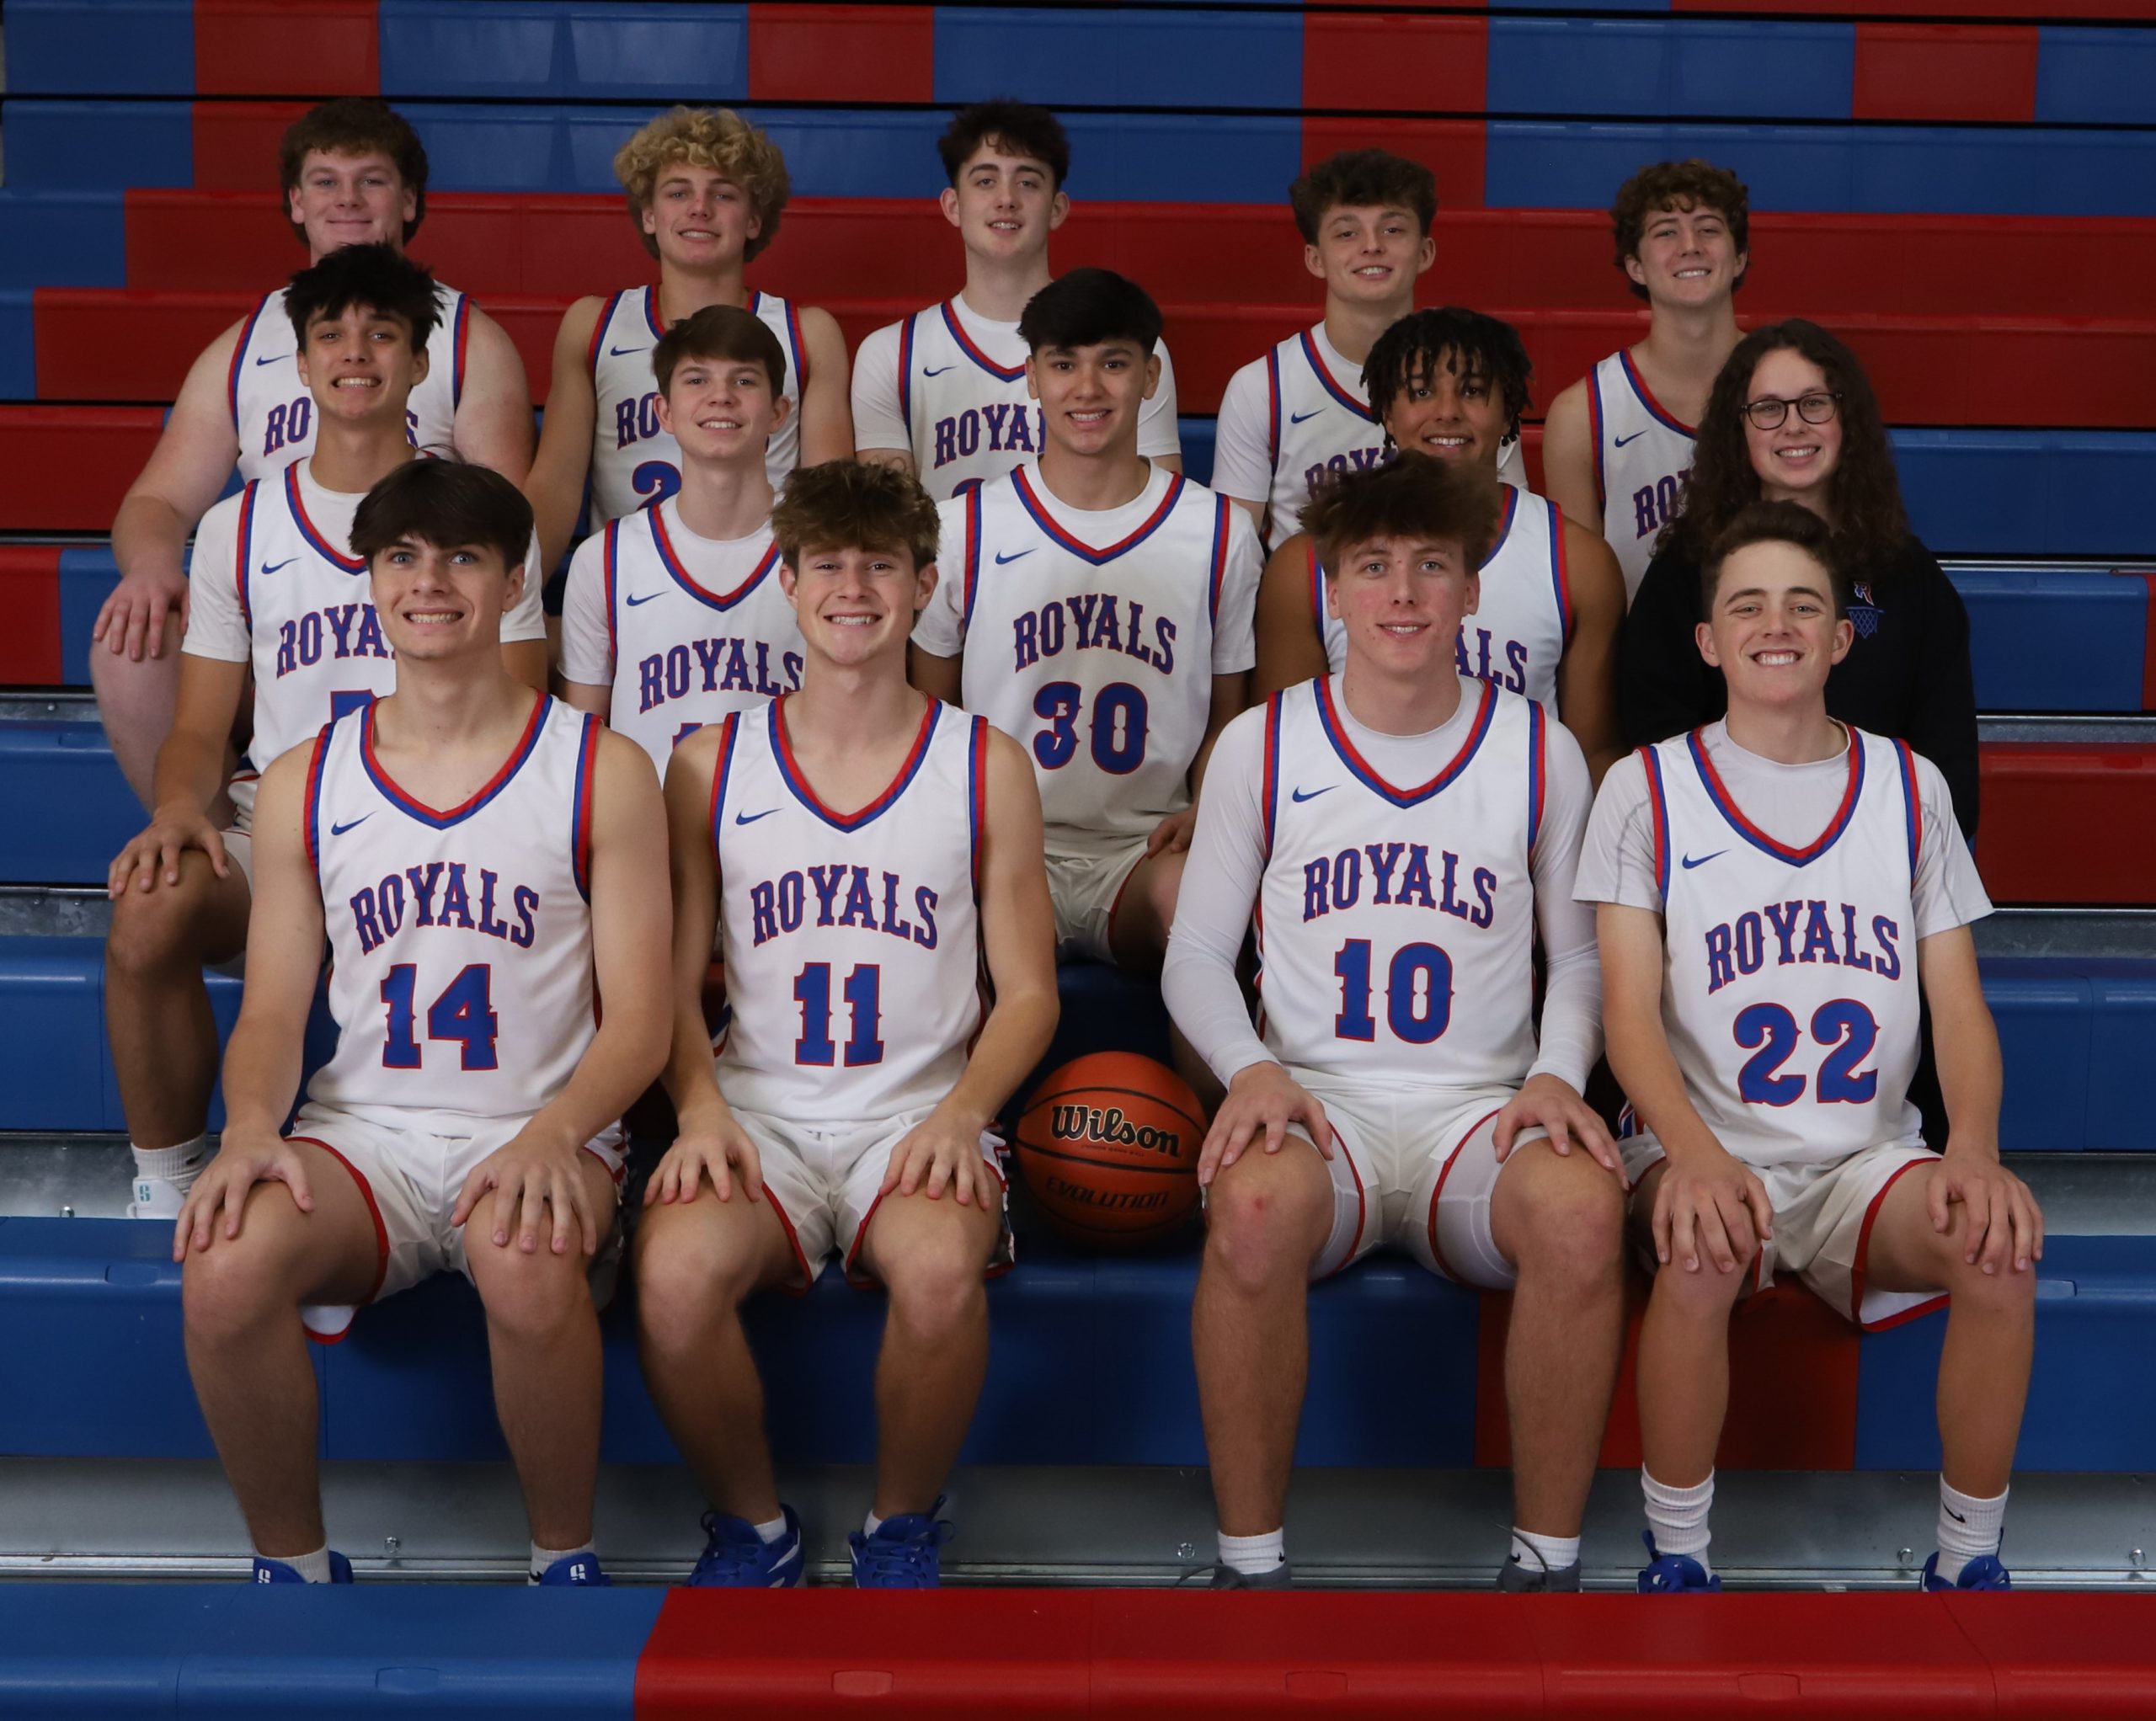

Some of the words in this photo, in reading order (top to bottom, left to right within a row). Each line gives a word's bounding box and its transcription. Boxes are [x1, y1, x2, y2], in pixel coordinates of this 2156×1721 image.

[934, 403, 1046, 470] ROYA
[632, 460, 682, 512] 2
[276, 603, 396, 680] ROYA
[1013, 593, 1177, 675] ROYALS
[1454, 624, 1528, 696] ALS
[1033, 681, 1150, 775] 30
[350, 861, 540, 956] ROYALS
[750, 864, 939, 951] ROYALS
[1303, 842, 1497, 930] ROYALS
[1334, 937, 1456, 1045] 10
[1705, 899, 1901, 996] ROYALS
[380, 963, 499, 1071] 14
[793, 962, 885, 1068] 11
[1732, 998, 1881, 1108] 22
[1051, 1105, 1181, 1159] Wilson
[1044, 1176, 1170, 1210] EVOLUTION
